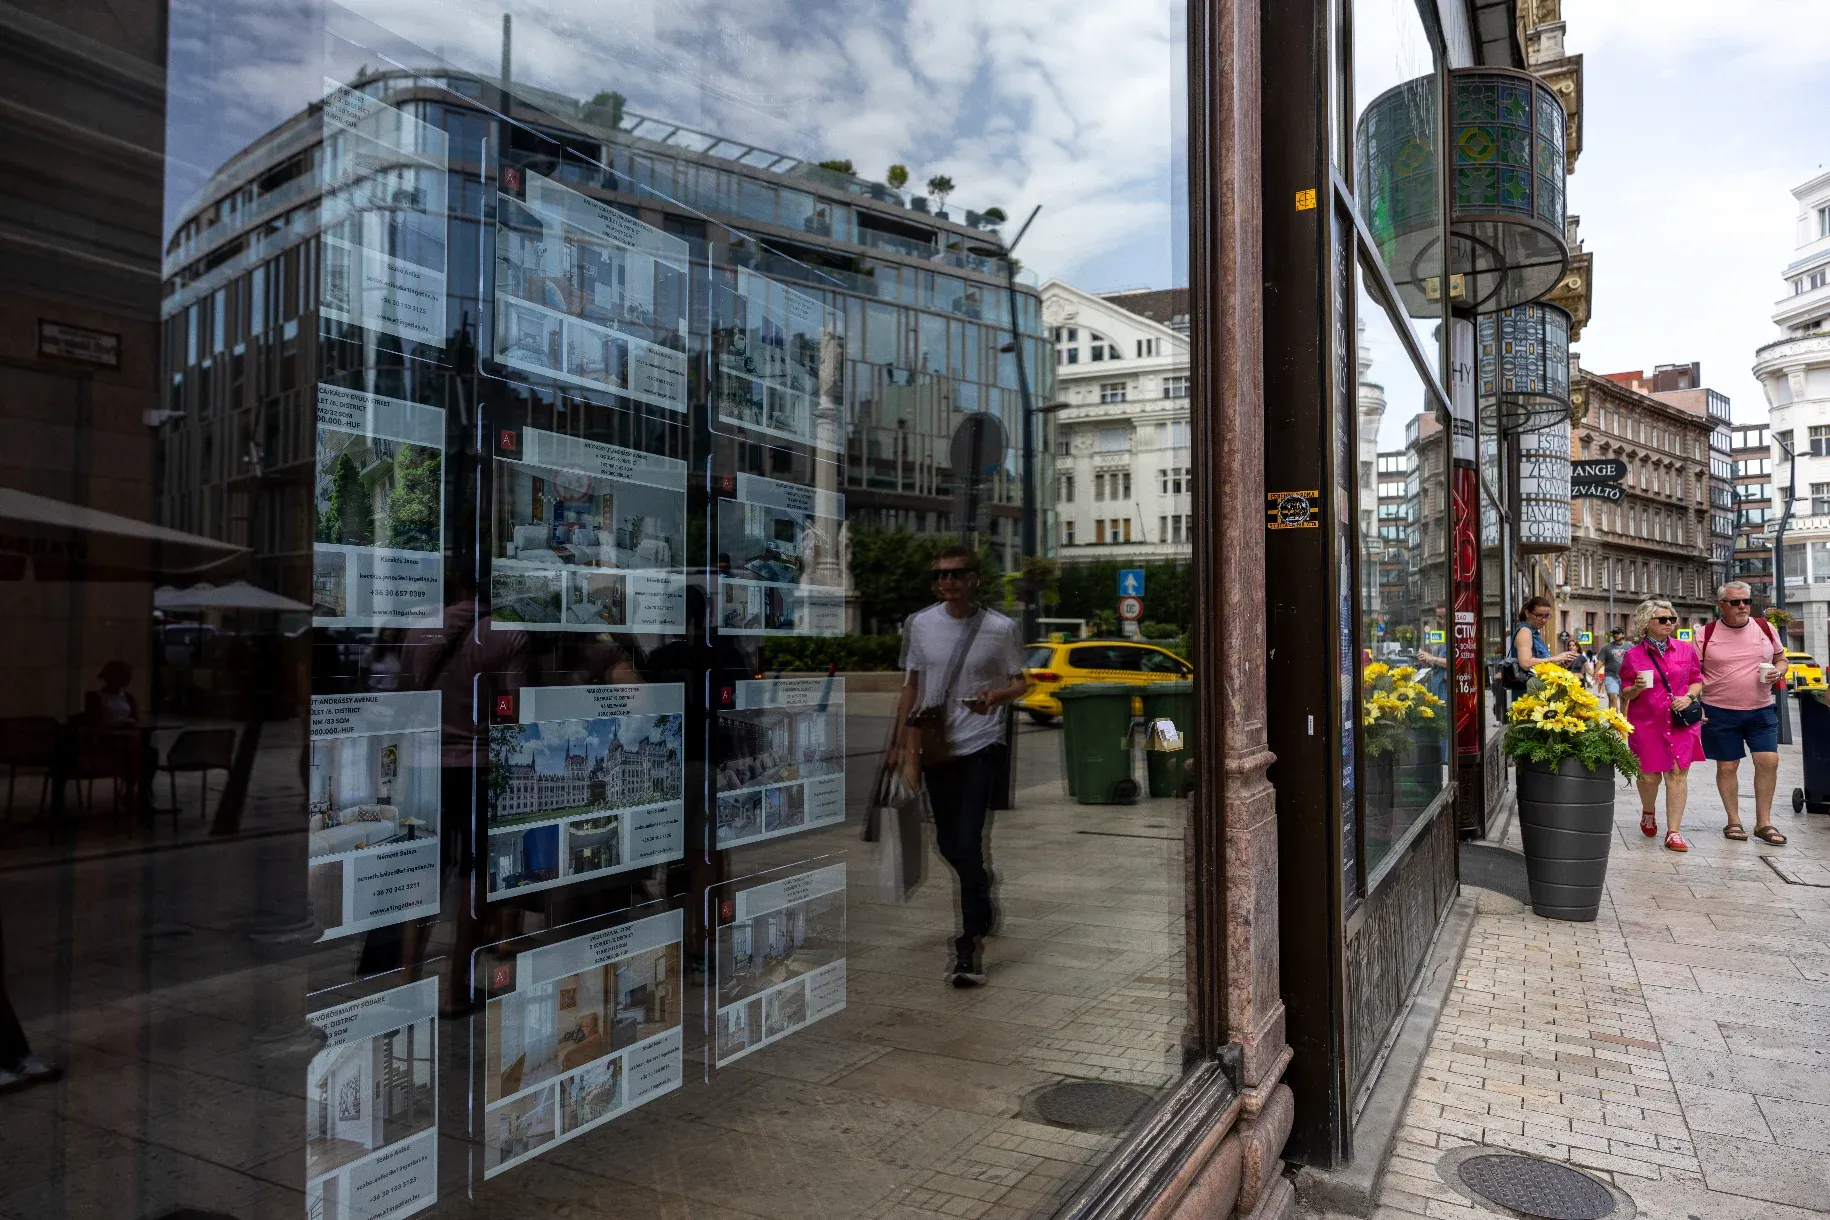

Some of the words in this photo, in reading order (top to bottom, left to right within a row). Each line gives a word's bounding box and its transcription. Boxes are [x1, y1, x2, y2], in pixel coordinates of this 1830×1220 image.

[1460, 682, 1469, 693] 16
[360, 996, 385, 1008] SQUARE
[331, 1014, 358, 1028] DISTRICT
